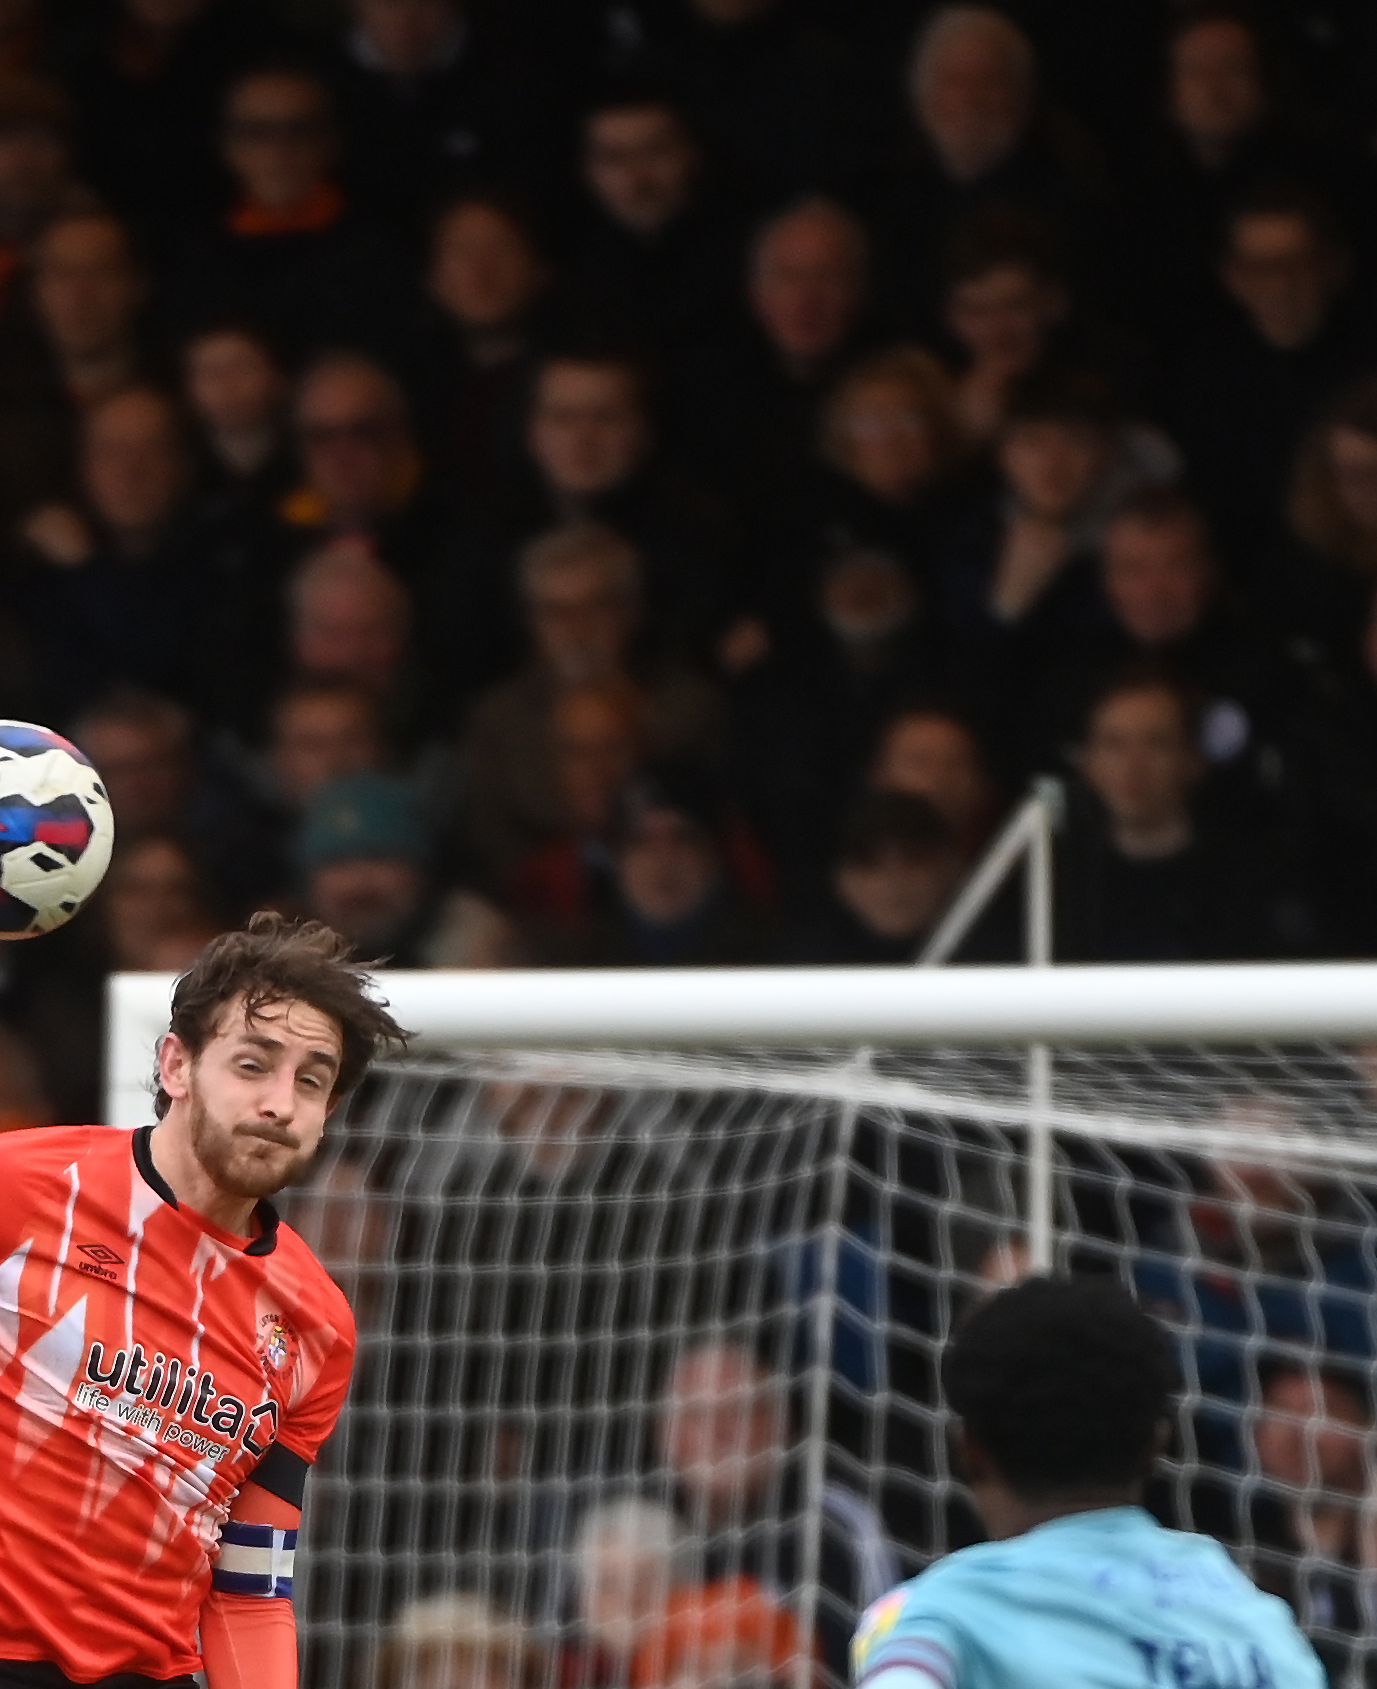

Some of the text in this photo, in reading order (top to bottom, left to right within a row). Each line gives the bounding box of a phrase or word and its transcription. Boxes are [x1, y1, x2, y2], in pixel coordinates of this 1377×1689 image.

[78, 1261, 117, 1280] umbro
[76, 1382, 230, 1462] life with power
[85, 1341, 246, 1441] utilita
